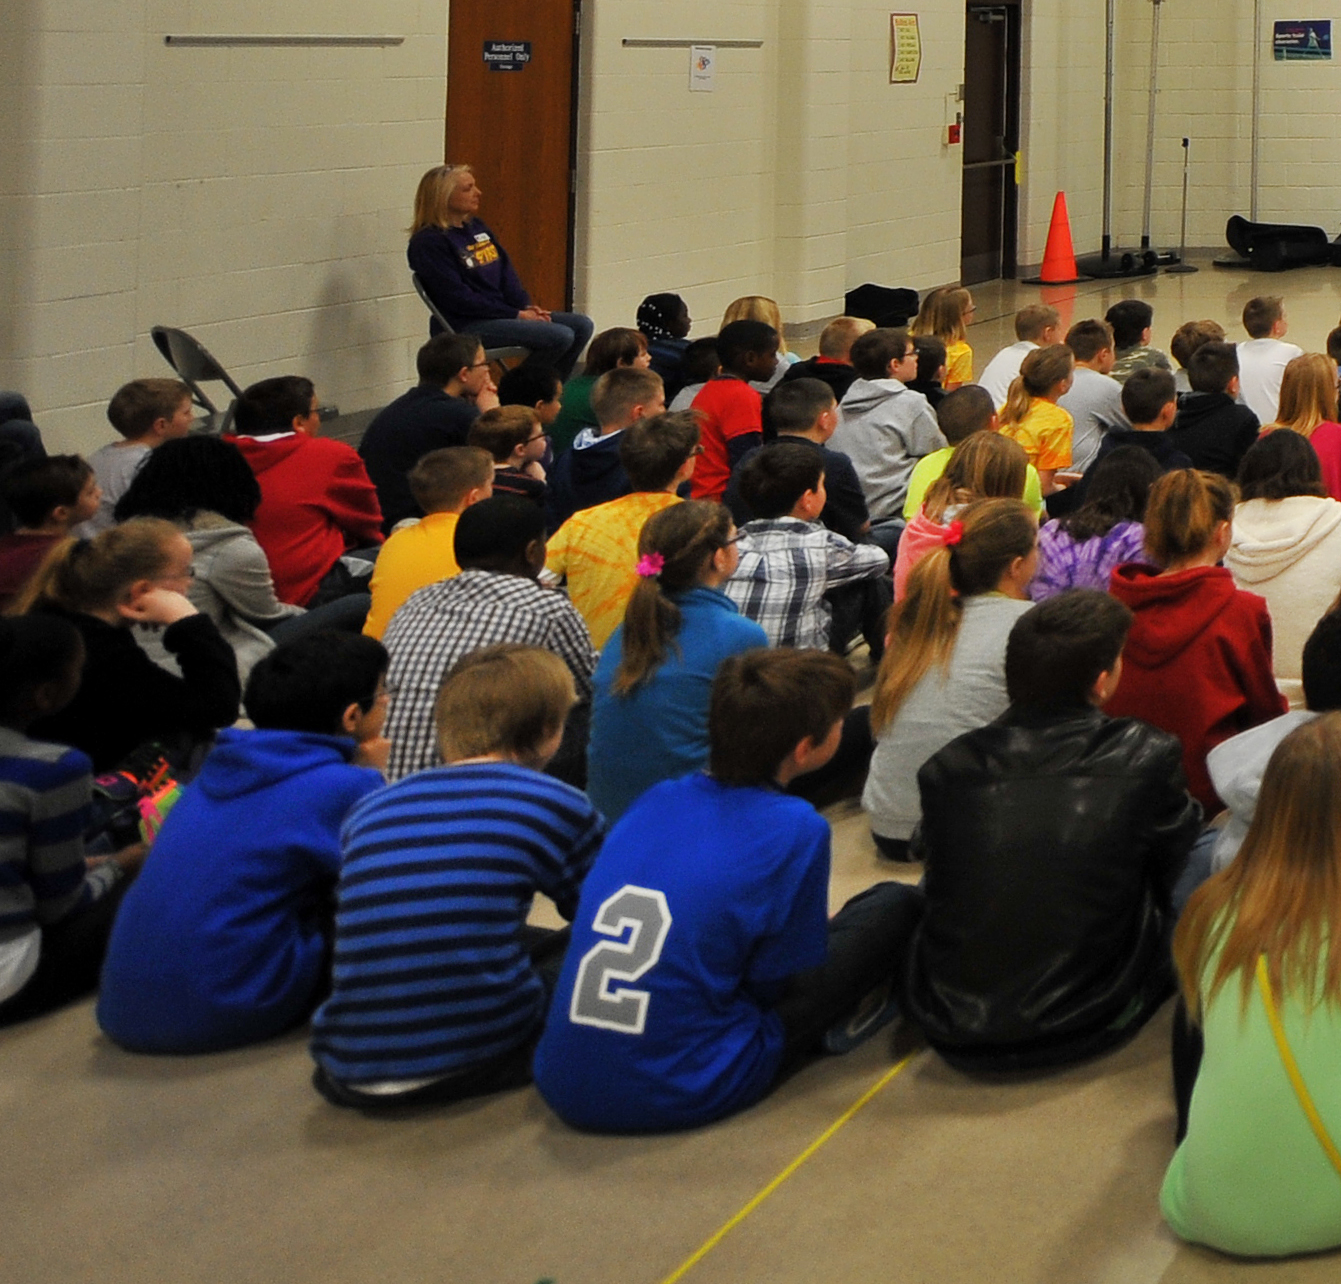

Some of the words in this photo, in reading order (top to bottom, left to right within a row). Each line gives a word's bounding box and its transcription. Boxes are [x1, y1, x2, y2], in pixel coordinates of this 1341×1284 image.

[491, 43, 524, 52] Authorized
[484, 52, 513, 61] Personnel
[515, 52, 530, 62] Only
[570, 884, 673, 1035] 2
